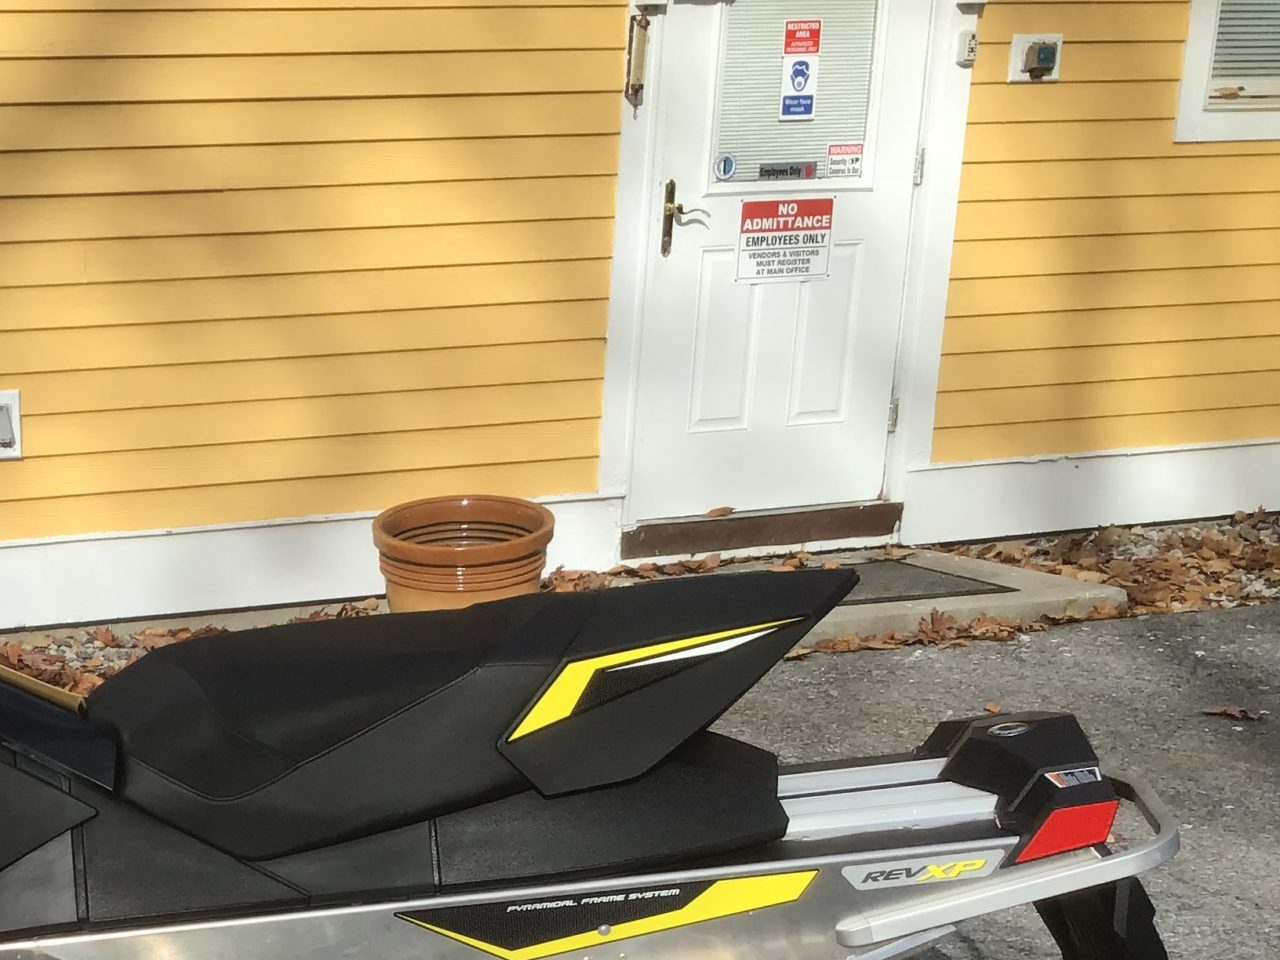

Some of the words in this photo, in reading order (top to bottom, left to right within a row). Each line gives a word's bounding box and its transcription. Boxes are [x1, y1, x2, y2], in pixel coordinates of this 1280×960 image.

[830, 145, 862, 154] WARNING
[760, 166, 789, 179] Employees
[789, 165, 802, 177] Only
[778, 203, 798, 215] NO
[742, 215, 831, 231] ADMITTANCE
[745, 234, 800, 247] EMPLOYEES
[802, 233, 826, 244] ONLY
[748, 251, 780, 259] VENDORS
[789, 249, 819, 258] VISITORS
[777, 258, 811, 267] REGISTER
[785, 266, 810, 274] OFFICE
[506, 899, 578, 913] PYRAMIDAL
[580, 893, 627, 905] FRAME
[628, 888, 681, 901] SYSTEM
